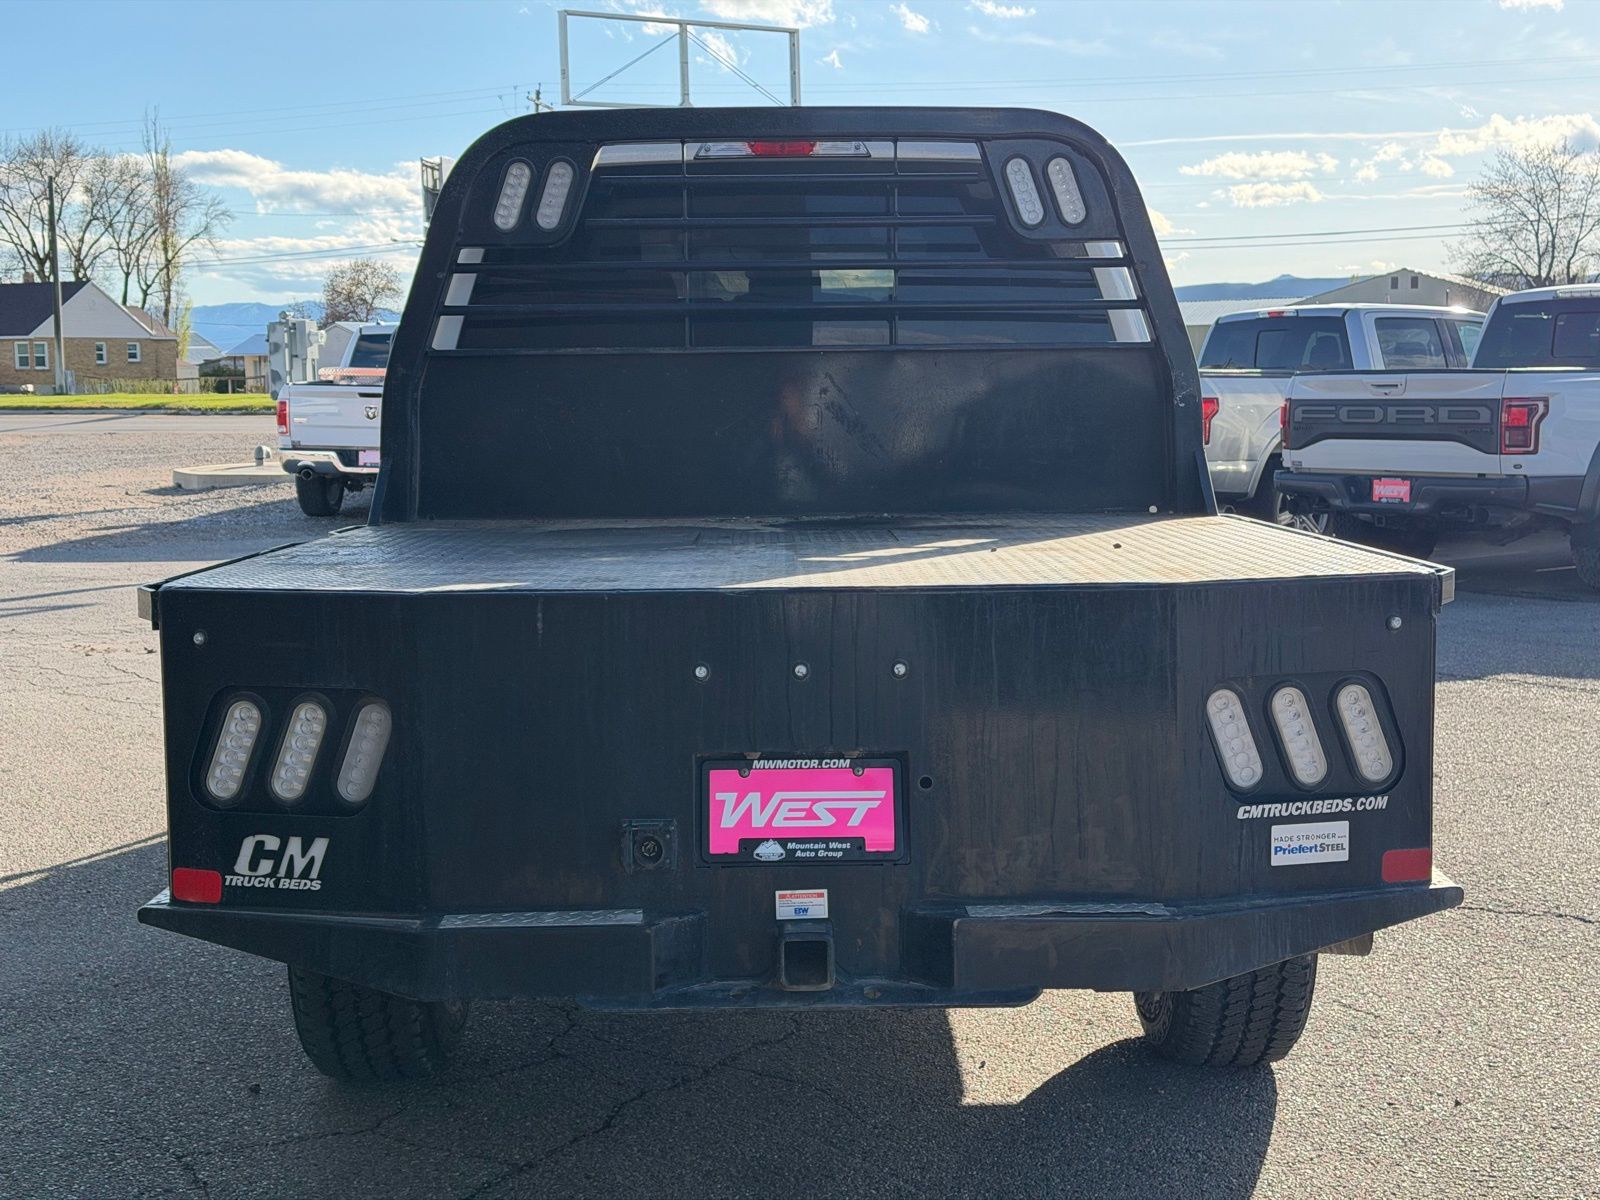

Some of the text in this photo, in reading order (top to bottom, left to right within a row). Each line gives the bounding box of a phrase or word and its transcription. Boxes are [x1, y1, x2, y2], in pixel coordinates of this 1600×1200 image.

[1294, 405, 1492, 425] FORD
[752, 759, 851, 770] MWMOTOR.COM
[715, 791, 886, 828] WEST
[1236, 795, 1389, 820] CMTRUCKBEDS.COM
[787, 841, 851, 850] Mountain West
[1273, 835, 1295, 843] MADE
[1296, 832, 1337, 842] STRONGER
[233, 834, 330, 880] CM
[795, 849, 843, 858] Auto Group
[225, 875, 322, 891] TRUCK BEDS
